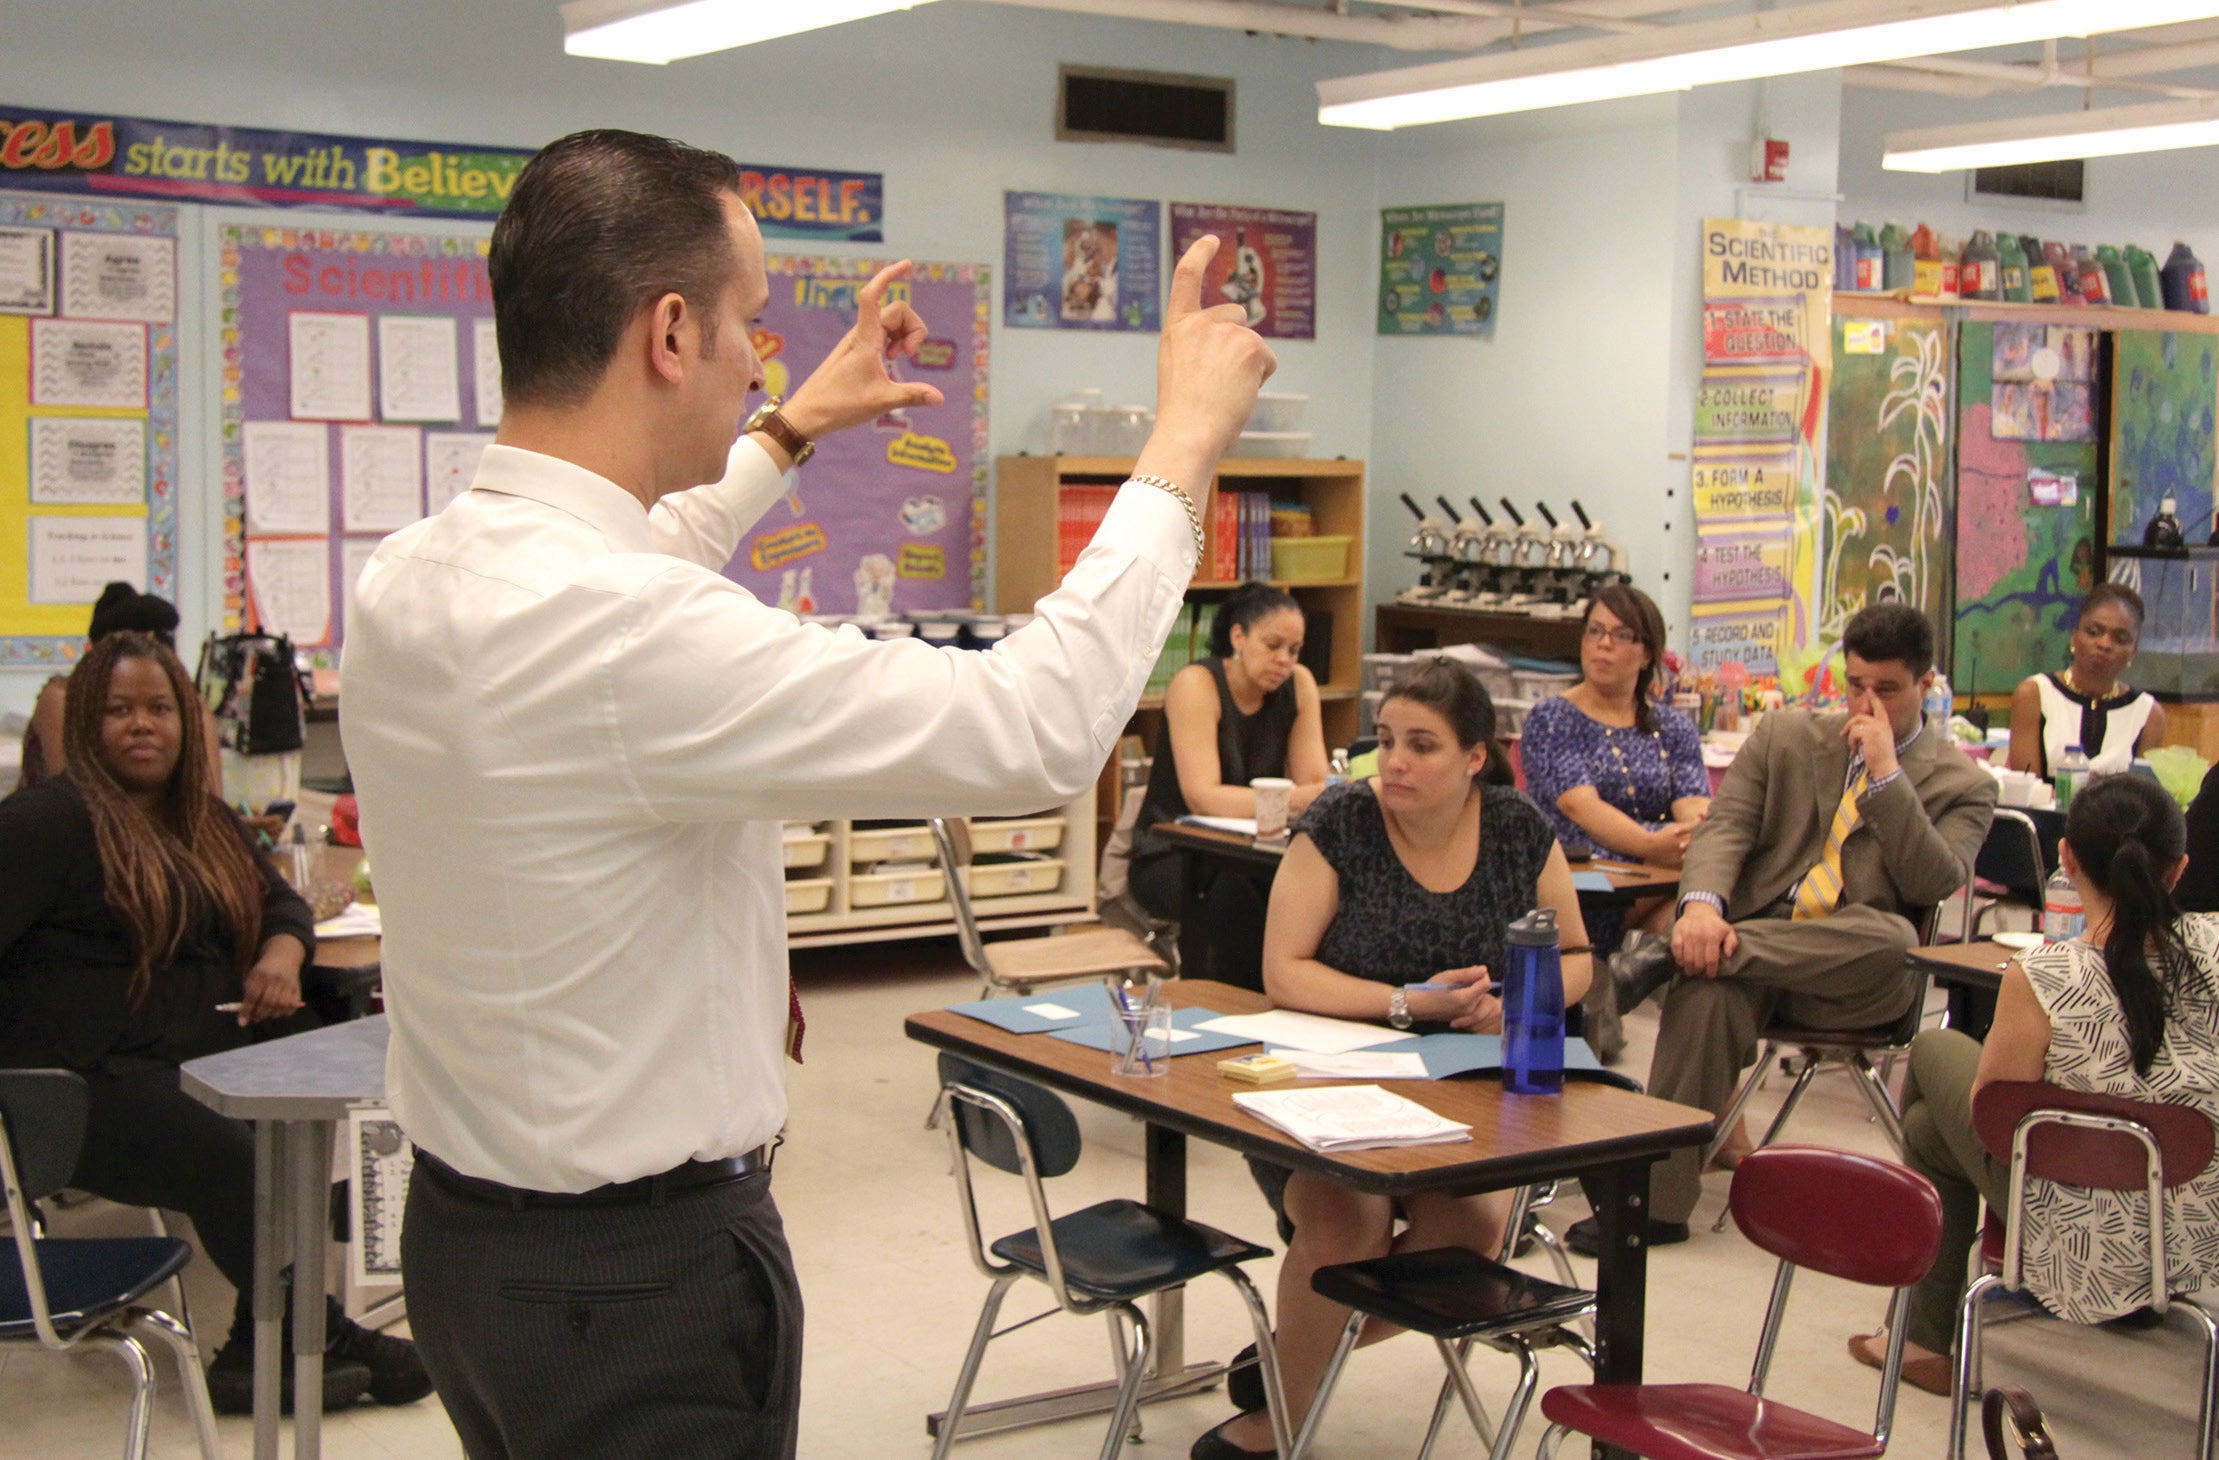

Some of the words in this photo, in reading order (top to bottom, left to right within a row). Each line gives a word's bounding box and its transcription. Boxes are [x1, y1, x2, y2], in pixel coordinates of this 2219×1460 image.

[124, 137, 250, 183] starts
[262, 146, 355, 190] with
[366, 148, 528, 198] Believ
[1725, 310, 1767, 328] STATE
[1768, 309, 1794, 326] THE
[1725, 333, 1796, 353] QUESTION
[1713, 389, 1774, 406] COLLECT
[1712, 469, 1748, 487] FORM
[1755, 468, 1764, 484] A
[1710, 490, 1783, 510] HYPOTHESIS
[1715, 546, 1739, 564] TEST
[1743, 543, 1762, 561] THE
[1713, 566, 1782, 586] HYPOTHESIS
[1705, 624, 1748, 644] RECORD
[1751, 622, 1774, 640] AND
[1702, 647, 1740, 668] STUDY
[1743, 645, 1773, 663] DATA
